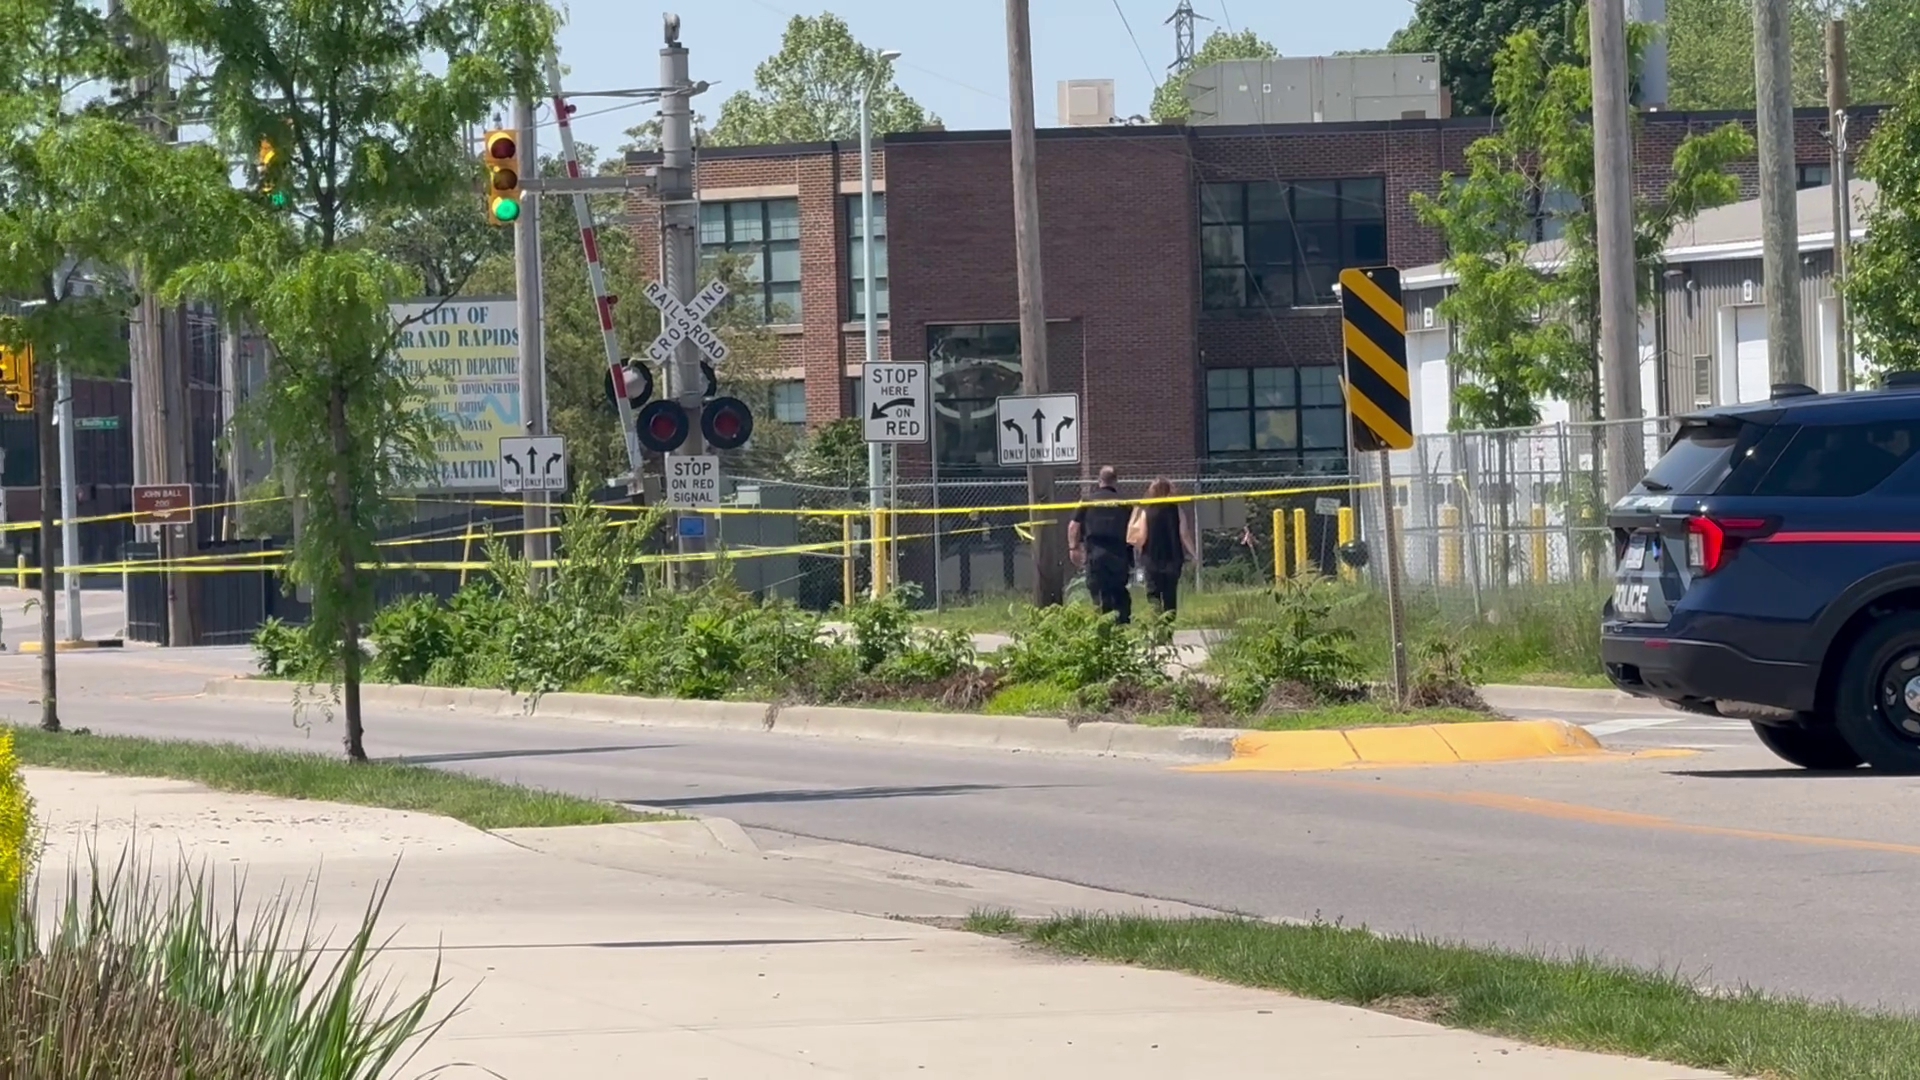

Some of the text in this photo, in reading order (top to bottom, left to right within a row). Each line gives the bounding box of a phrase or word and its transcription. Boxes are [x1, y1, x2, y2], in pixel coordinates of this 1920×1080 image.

[422, 306, 488, 325] CITY OF
[646, 283, 724, 359] RAILROAD
[650, 282, 724, 360] CROSSING
[458, 328, 519, 347] RAPIDS
[873, 368, 918, 384] STOP
[443, 383, 458, 395] AND
[461, 382, 520, 395] ADMINISTRATIO
[881, 386, 909, 396] HERE
[896, 408, 911, 418] ON
[886, 421, 920, 436] RED
[1003, 449, 1023, 460] ONLY
[1030, 448, 1050, 459] ONLY
[1056, 447, 1075, 458] ONLY
[674, 462, 711, 476] STOP
[503, 479, 519, 487] ONLY
[525, 478, 541, 487] ONLY
[547, 478, 562, 486] ONLY
[672, 479, 714, 489] ON RED
[142, 489, 182, 498] JOHN BALL
[674, 492, 712, 502] SIGNAL
[1615, 585, 1649, 614] POLICE
